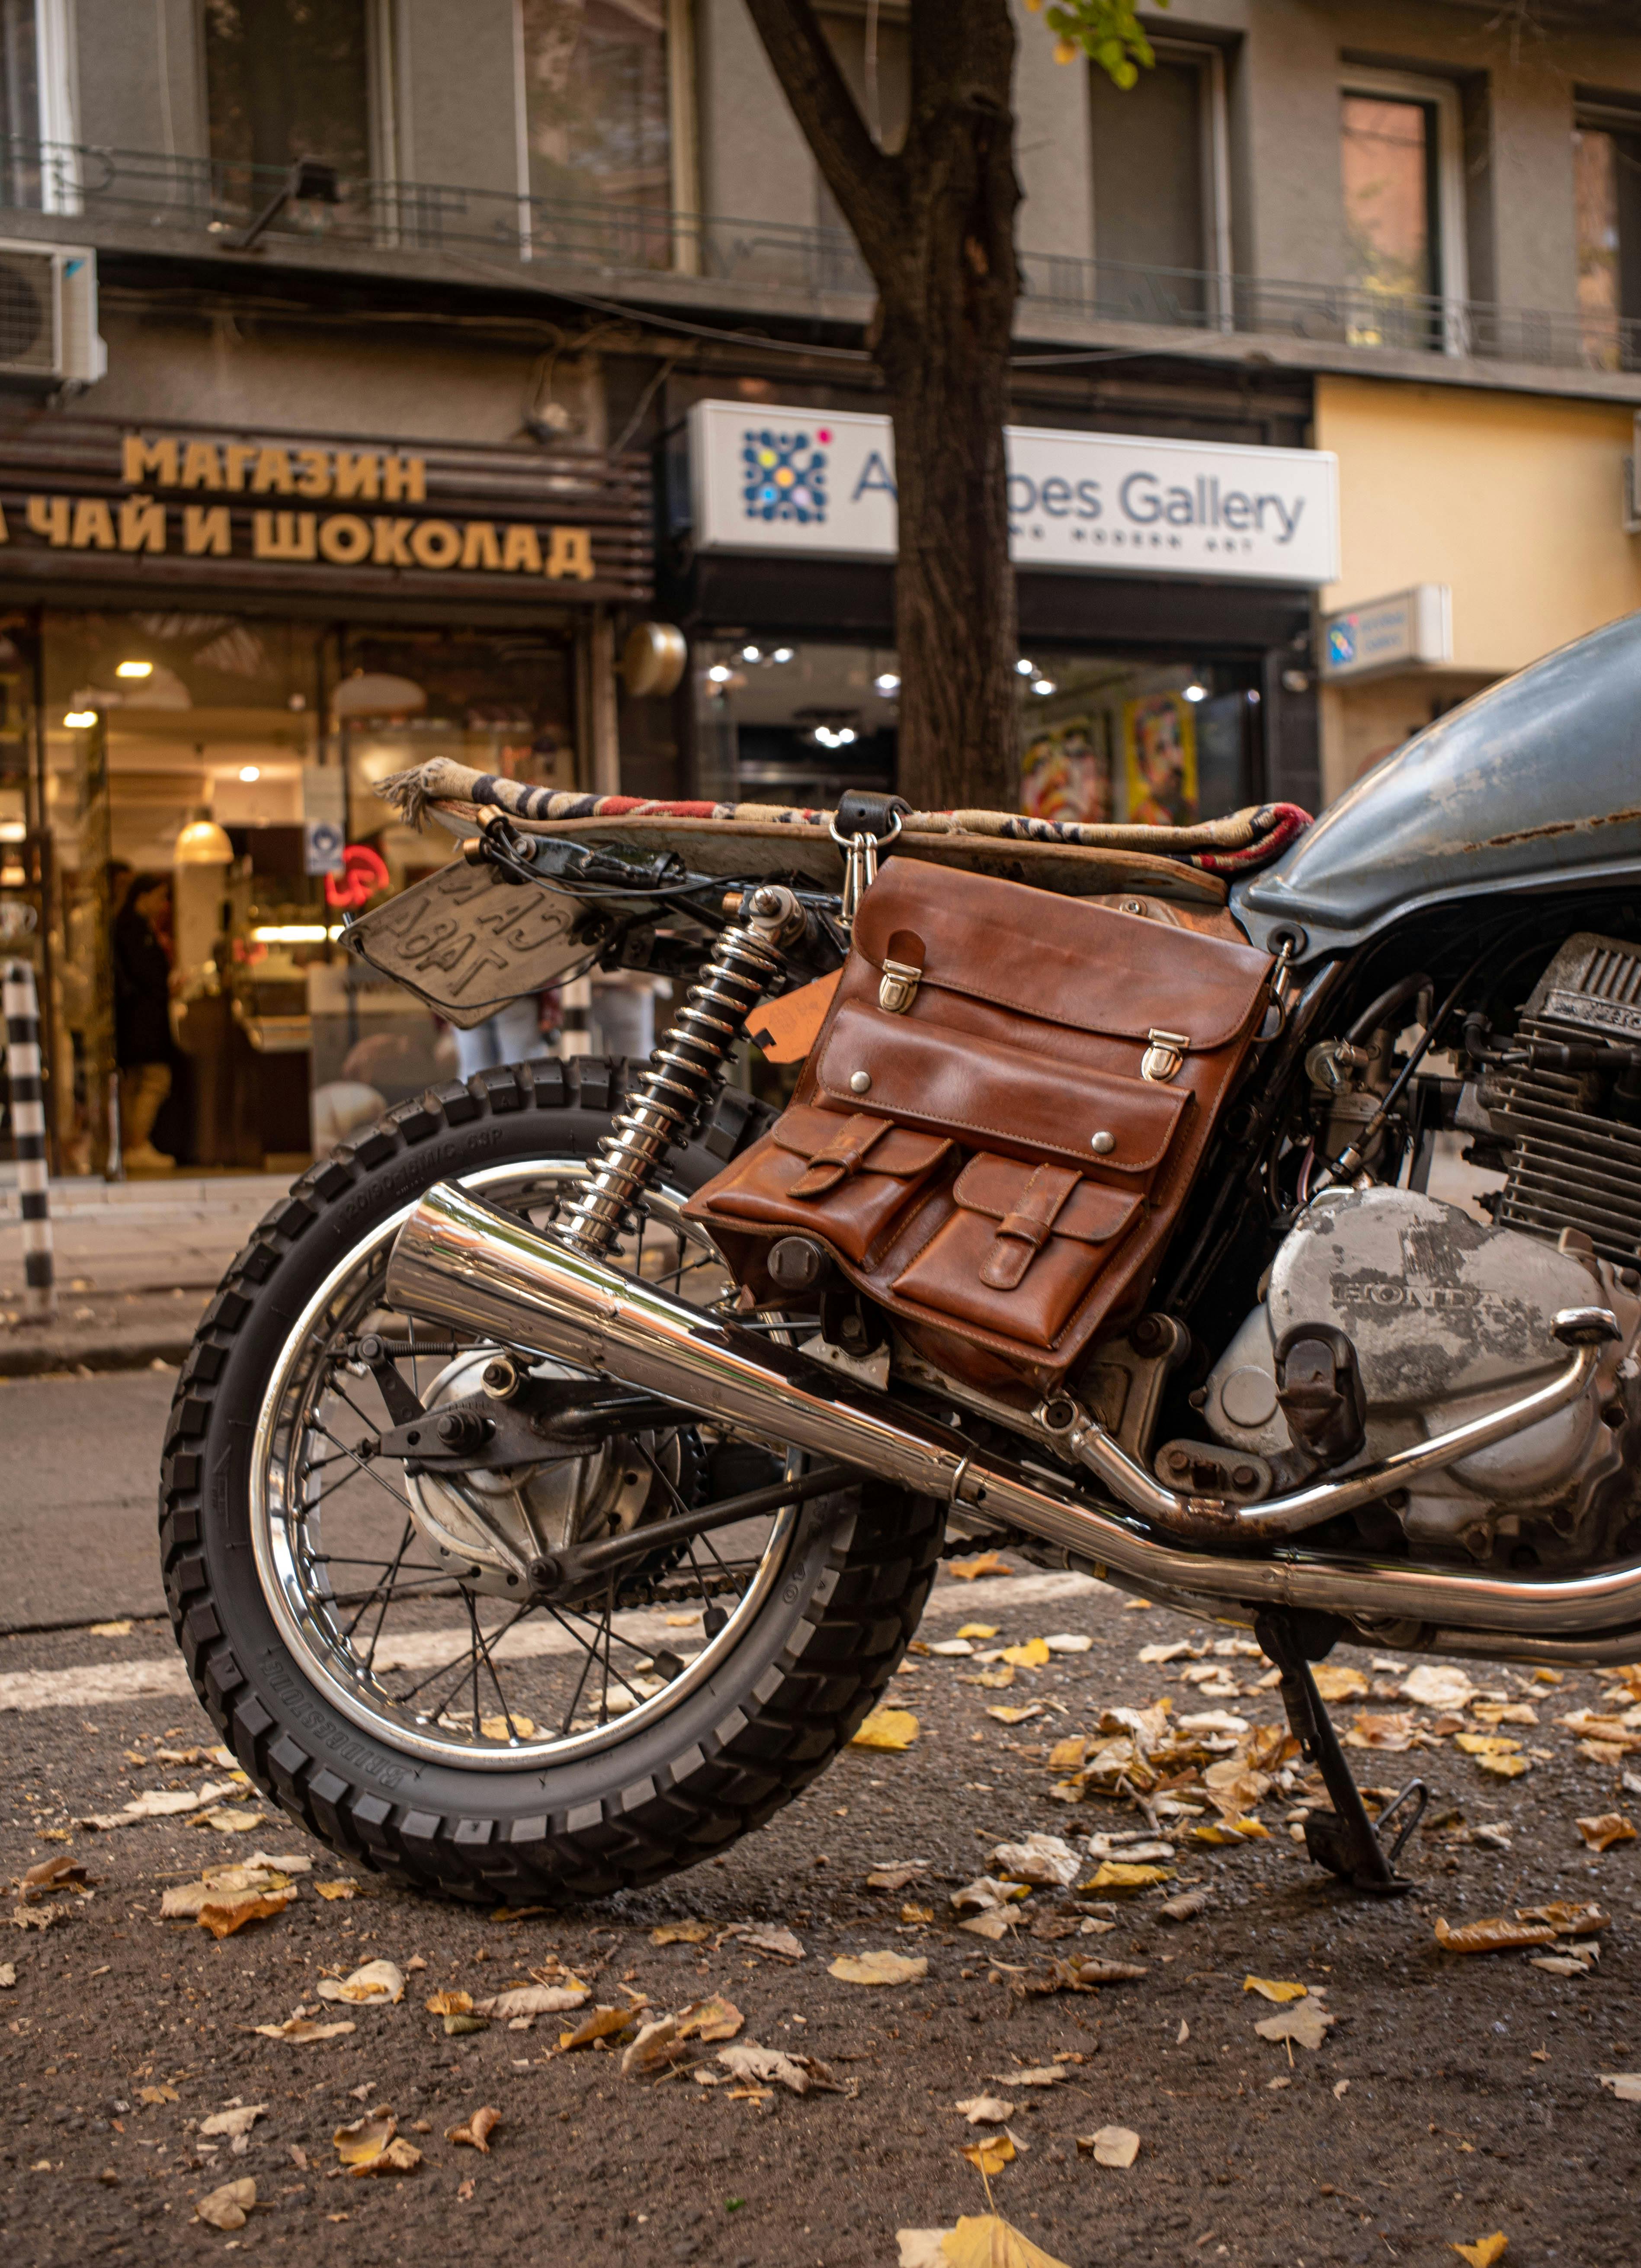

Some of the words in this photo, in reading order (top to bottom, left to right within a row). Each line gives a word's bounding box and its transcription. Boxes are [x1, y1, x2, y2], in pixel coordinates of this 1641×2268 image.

[123, 435, 427, 502] МАГАЗИН
[27, 494, 167, 553] ЧАЙ
[183, 506, 232, 555] И
[253, 510, 596, 582] ШОКОЛАД
[1119, 470, 1305, 544] Gallery
[1333, 1280, 1507, 1312] HONDA
[260, 1659, 413, 1788] BRIDGESTONE
